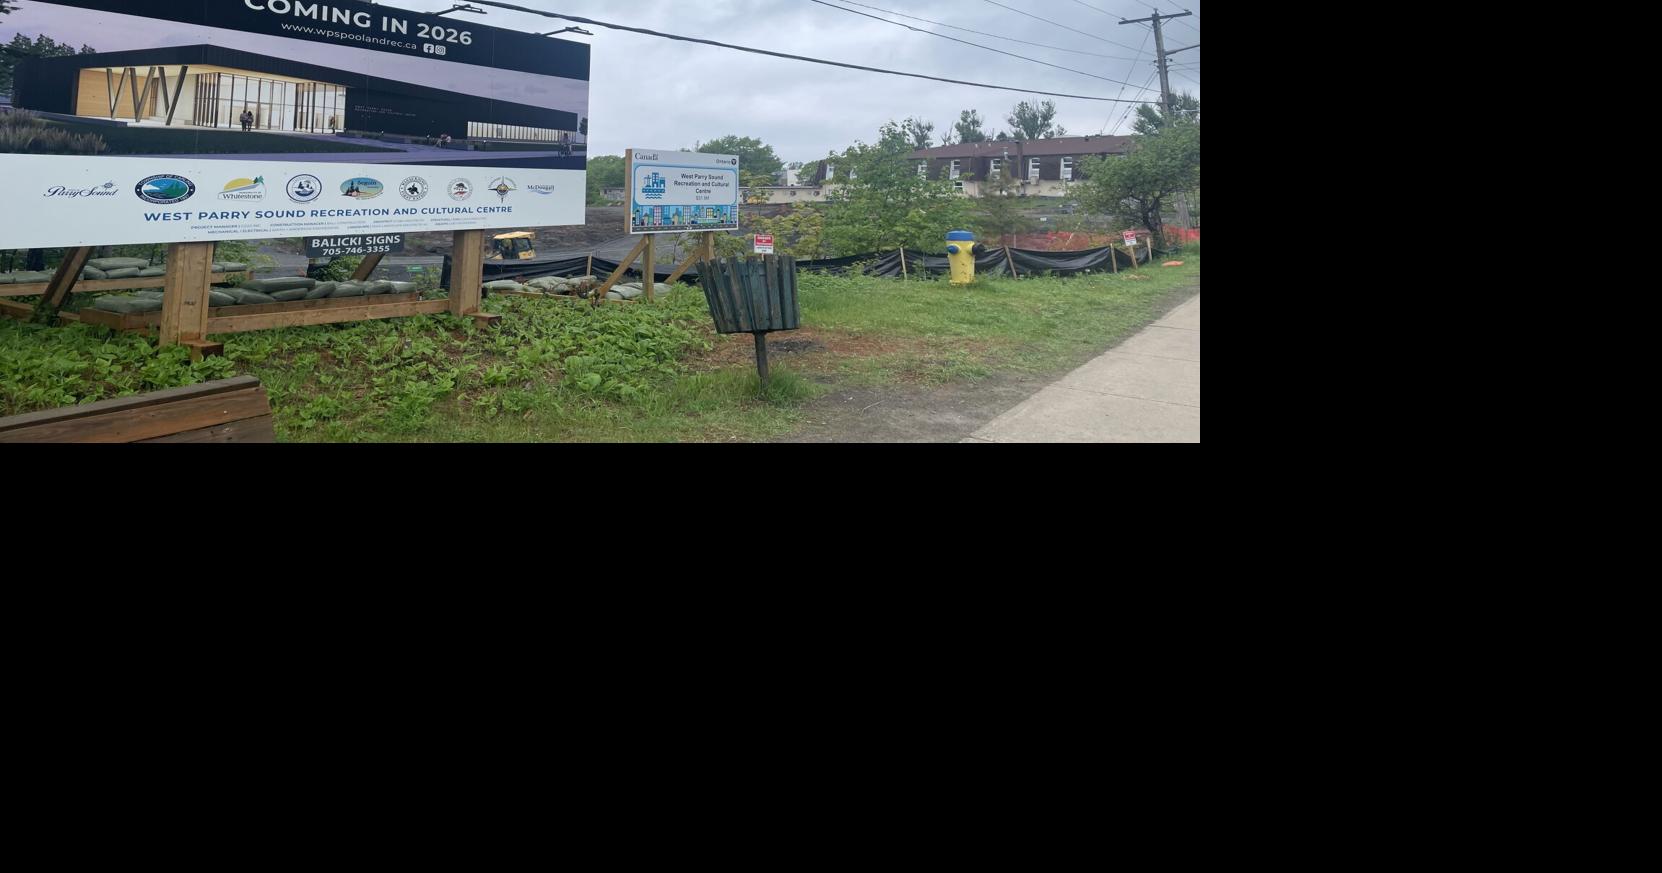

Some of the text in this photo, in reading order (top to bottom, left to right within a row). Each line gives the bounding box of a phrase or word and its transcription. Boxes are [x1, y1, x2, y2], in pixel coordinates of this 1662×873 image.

[245, 0, 472, 45] COMING IN 2026
[281, 23, 417, 50] www.wpspoolandrec.ca
[635, 152, 659, 161] Canada
[144, 206, 513, 221] WEST PARRY SOUND RECREATION AND CULTURAL CENTRE
[312, 235, 401, 248] BALICKI SIGNS
[322, 245, 390, 256] 705-746-3355
